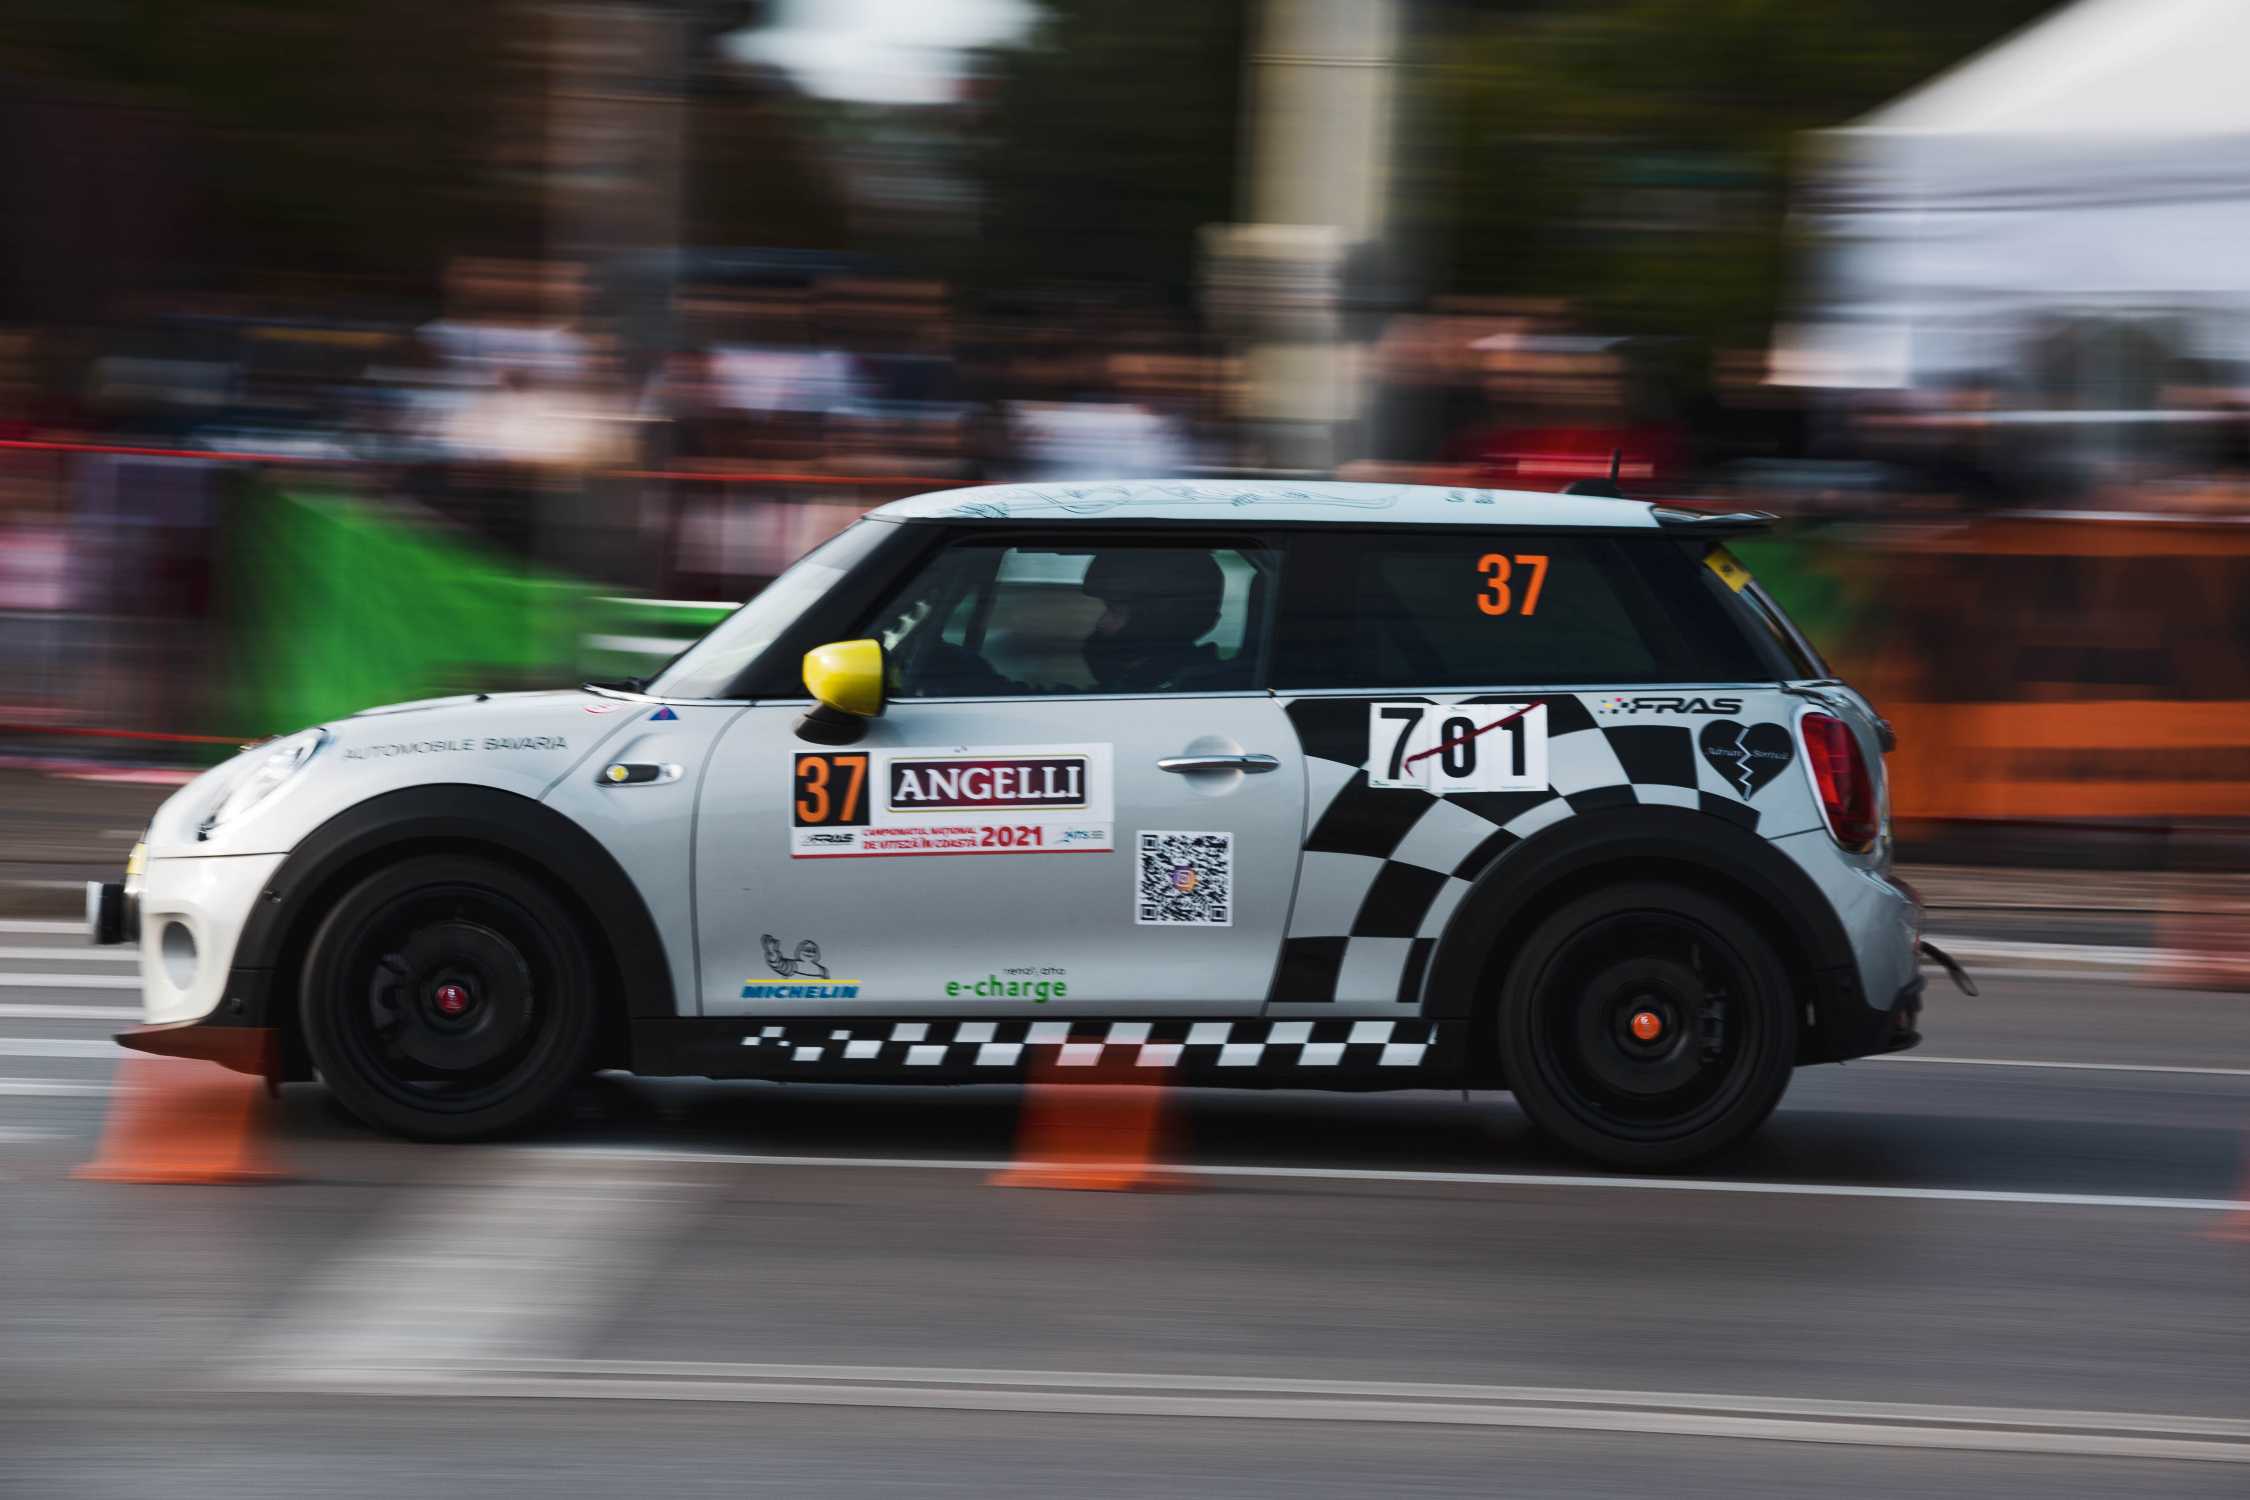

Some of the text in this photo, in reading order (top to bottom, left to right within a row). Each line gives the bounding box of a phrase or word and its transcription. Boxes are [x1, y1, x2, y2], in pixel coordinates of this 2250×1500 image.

[1476, 553, 1549, 616] 37
[1629, 697, 1745, 715] FRAS
[343, 738, 475, 760] AUTOMOBILE
[1381, 707, 1526, 780] 701
[796, 755, 867, 823] 37
[893, 766, 1082, 801] ANGELLI
[981, 826, 1043, 847] 2021
[741, 985, 860, 998] MICHELIN
[945, 974, 1067, 1004] e-charge
